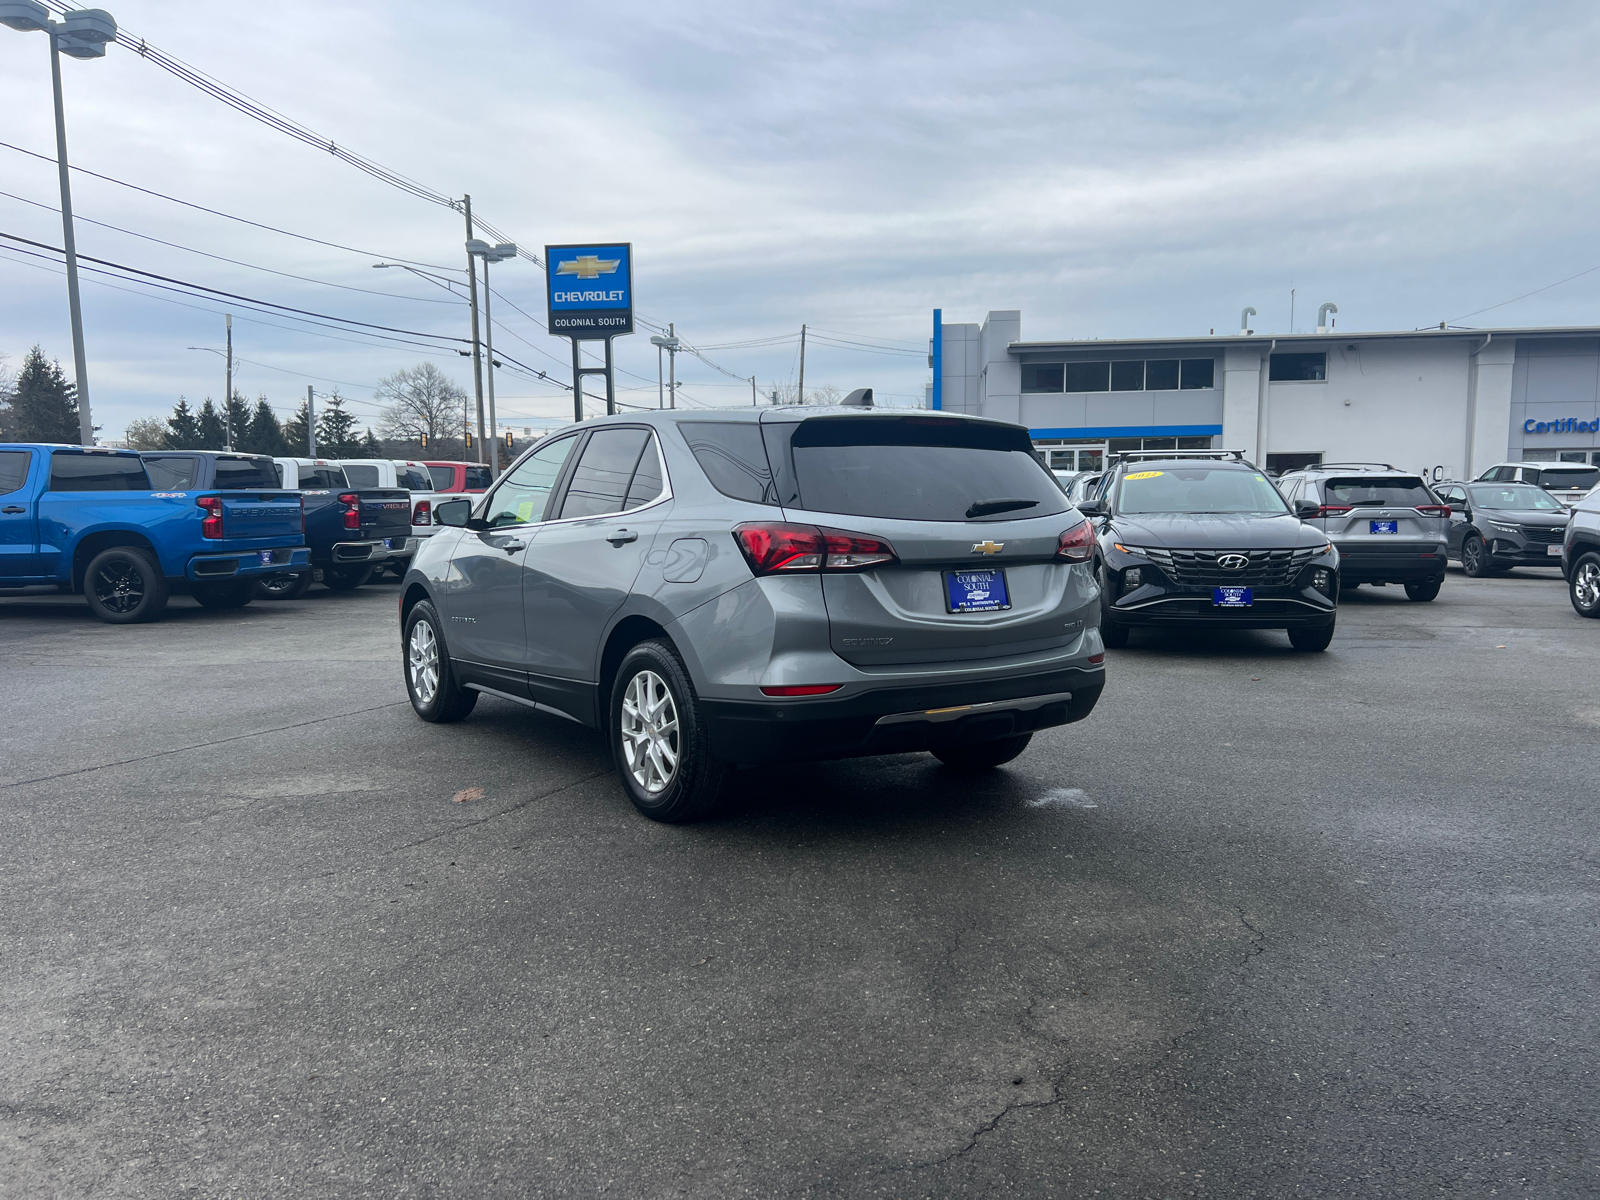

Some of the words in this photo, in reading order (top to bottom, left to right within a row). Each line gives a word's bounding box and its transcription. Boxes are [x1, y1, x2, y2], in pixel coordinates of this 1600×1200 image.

[554, 290, 624, 302] CHEVROLET
[554, 318, 596, 327] COLONIAL
[598, 317, 626, 326] SOUTH
[1523, 416, 1600, 434] Certified
[231, 508, 301, 517] CHEVROLET
[957, 574, 994, 583] COLONIAL
[964, 582, 990, 591] SOUTH
[842, 636, 894, 647] EQUINOX
